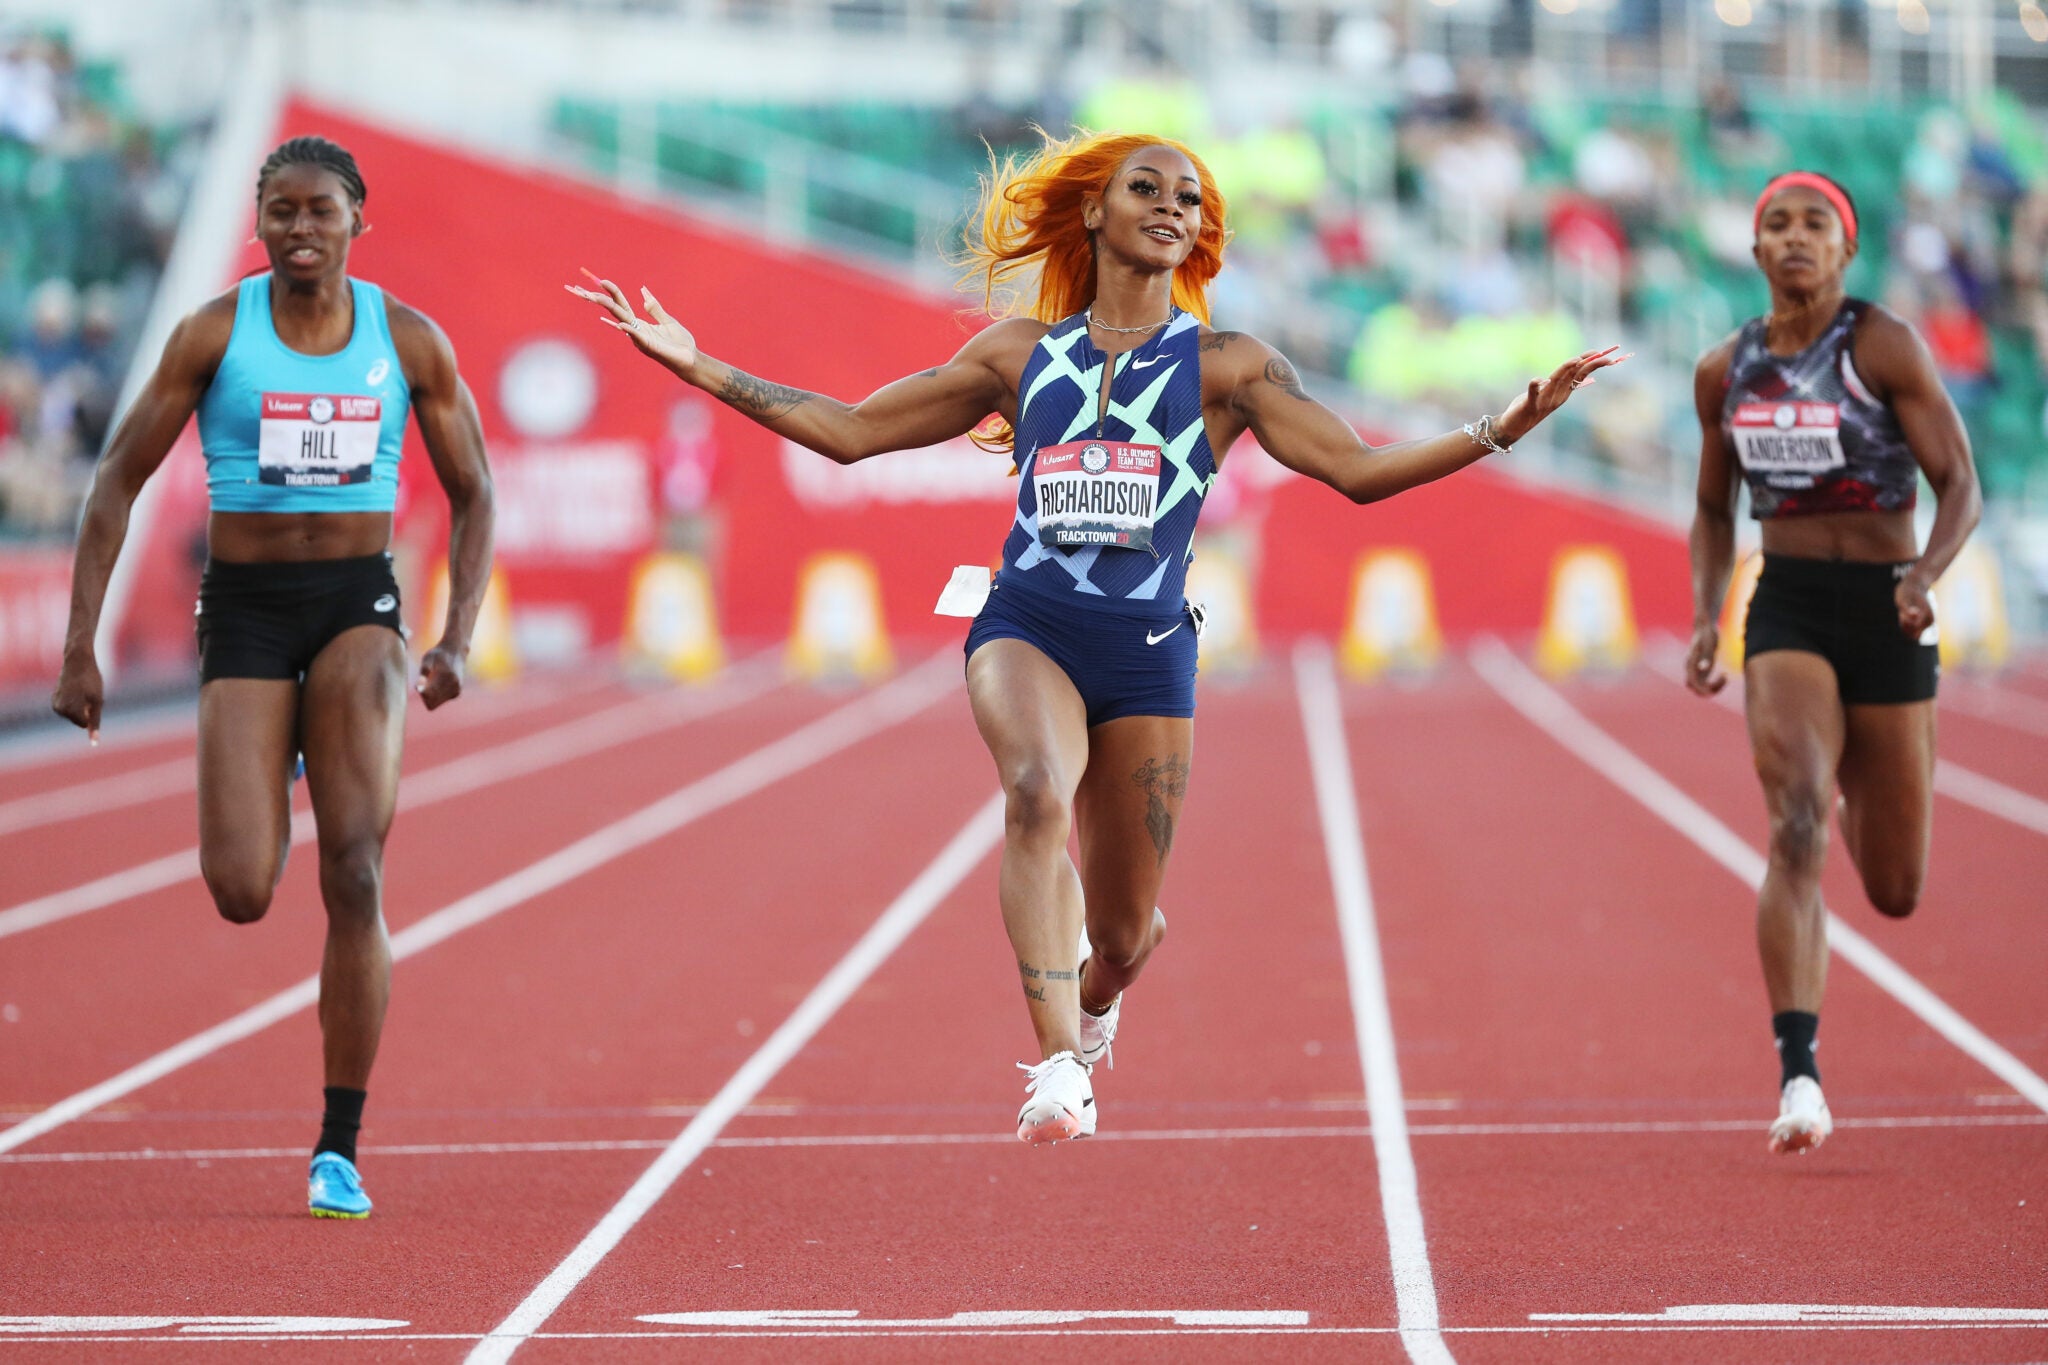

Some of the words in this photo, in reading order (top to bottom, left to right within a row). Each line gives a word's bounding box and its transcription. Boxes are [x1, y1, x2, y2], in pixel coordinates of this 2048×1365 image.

[301, 431, 339, 459] HILL
[1117, 447, 1129, 457] U.S.
[1130, 448, 1156, 459] OLYMPIC
[1746, 436, 1833, 462] ANDERSON
[1117, 456, 1134, 466] TEAM
[1135, 457, 1155, 468] TRIALS
[1040, 480, 1152, 518] RICHARDSON
